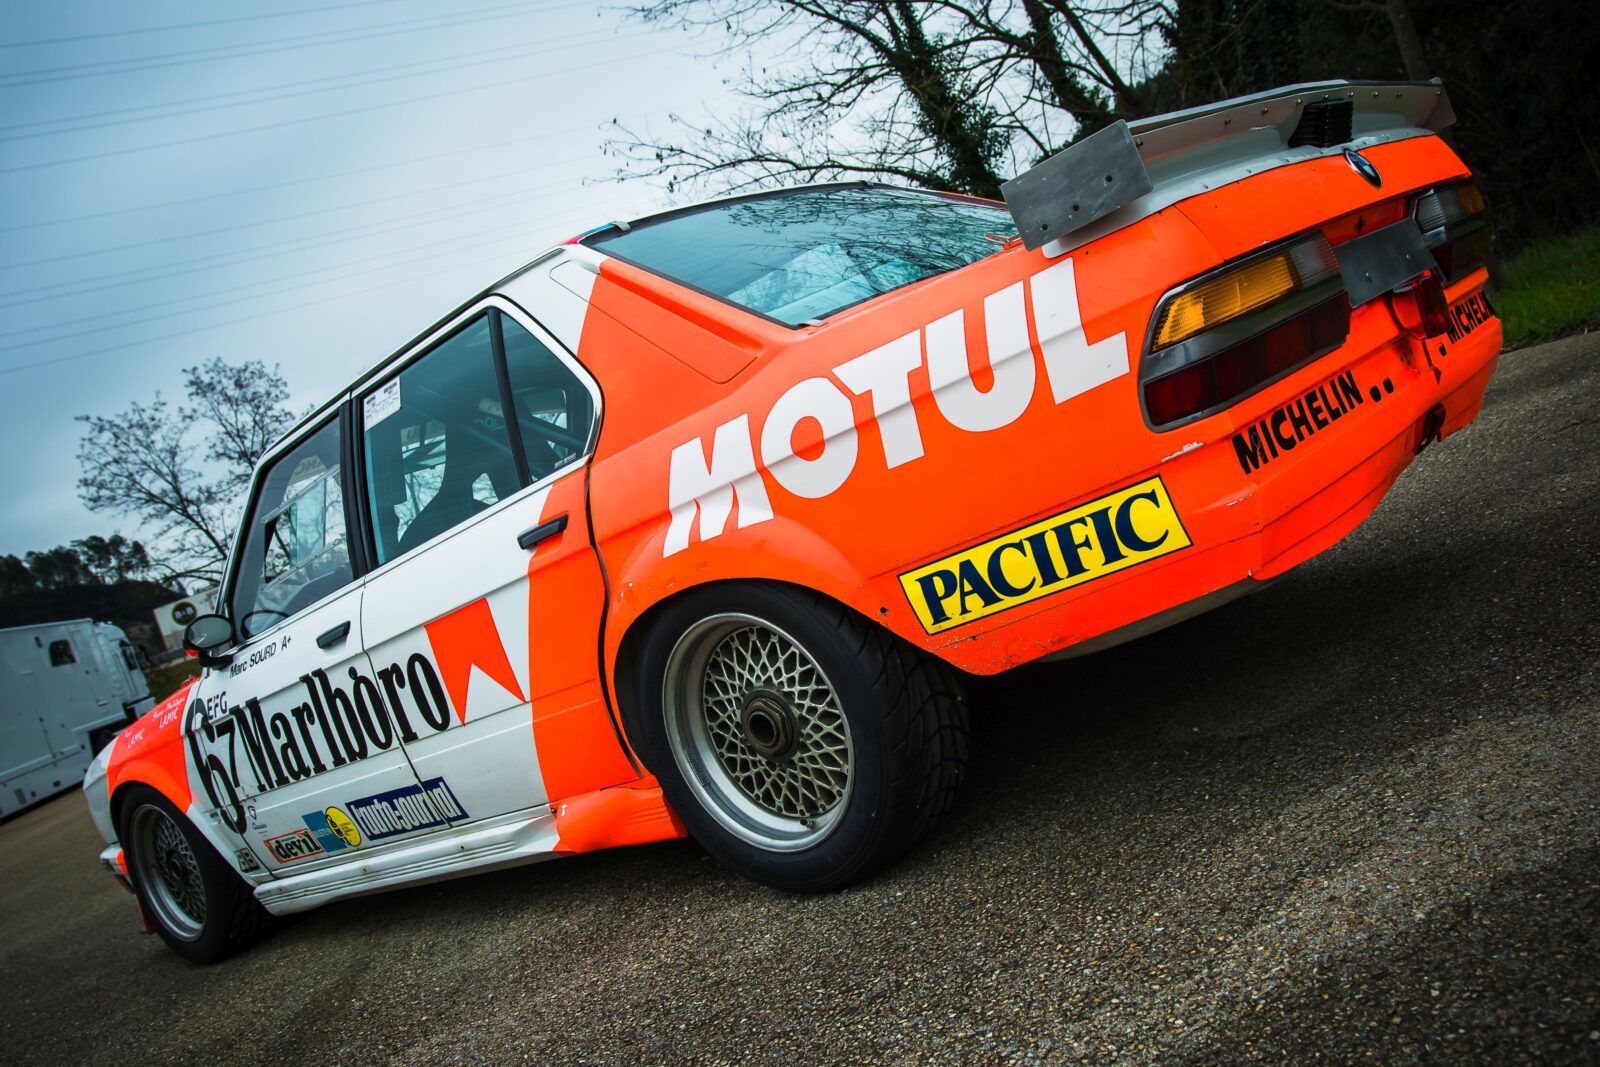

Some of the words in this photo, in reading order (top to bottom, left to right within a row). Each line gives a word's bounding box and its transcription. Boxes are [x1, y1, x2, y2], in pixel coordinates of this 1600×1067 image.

[662, 256, 1131, 559] MOTUL
[1231, 369, 1364, 476] MICHELIN
[914, 488, 1170, 627] PACIFIC
[229, 661, 247, 679] Marc
[249, 642, 277, 668] SOURD
[281, 635, 292, 651] A+
[229, 652, 451, 793] Marlboro
[274, 830, 321, 860] devil
